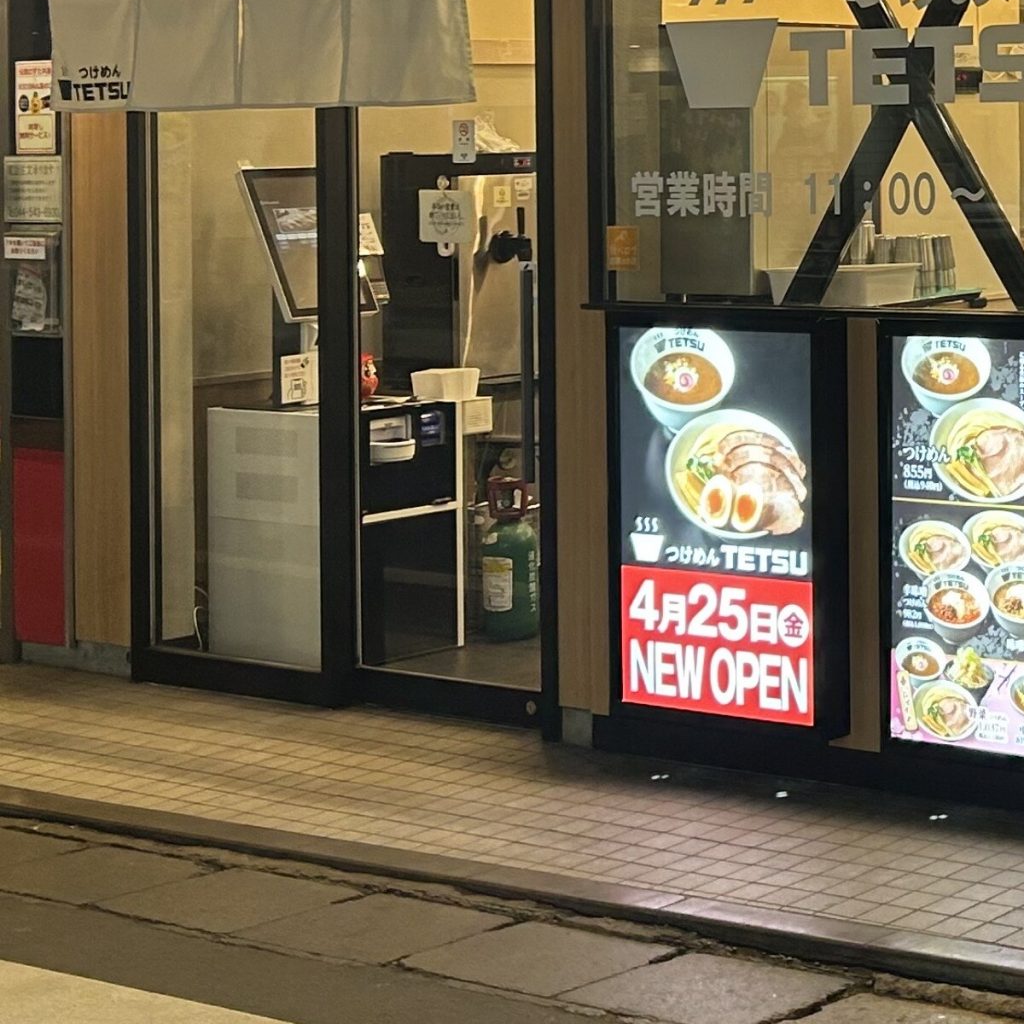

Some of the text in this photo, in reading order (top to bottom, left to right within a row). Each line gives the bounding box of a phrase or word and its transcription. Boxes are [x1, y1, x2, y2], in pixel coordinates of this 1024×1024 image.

[79, 65, 121, 79] つけめん
[73, 81, 131, 101] TETSU
[631, 171, 773, 217] 営業時間
[668, 337, 706, 352] TETSU
[902, 445, 951, 464] つけめん
[664, 544, 808, 576] つけめん TETSU
[629, 638, 808, 714] NEW OPEN
